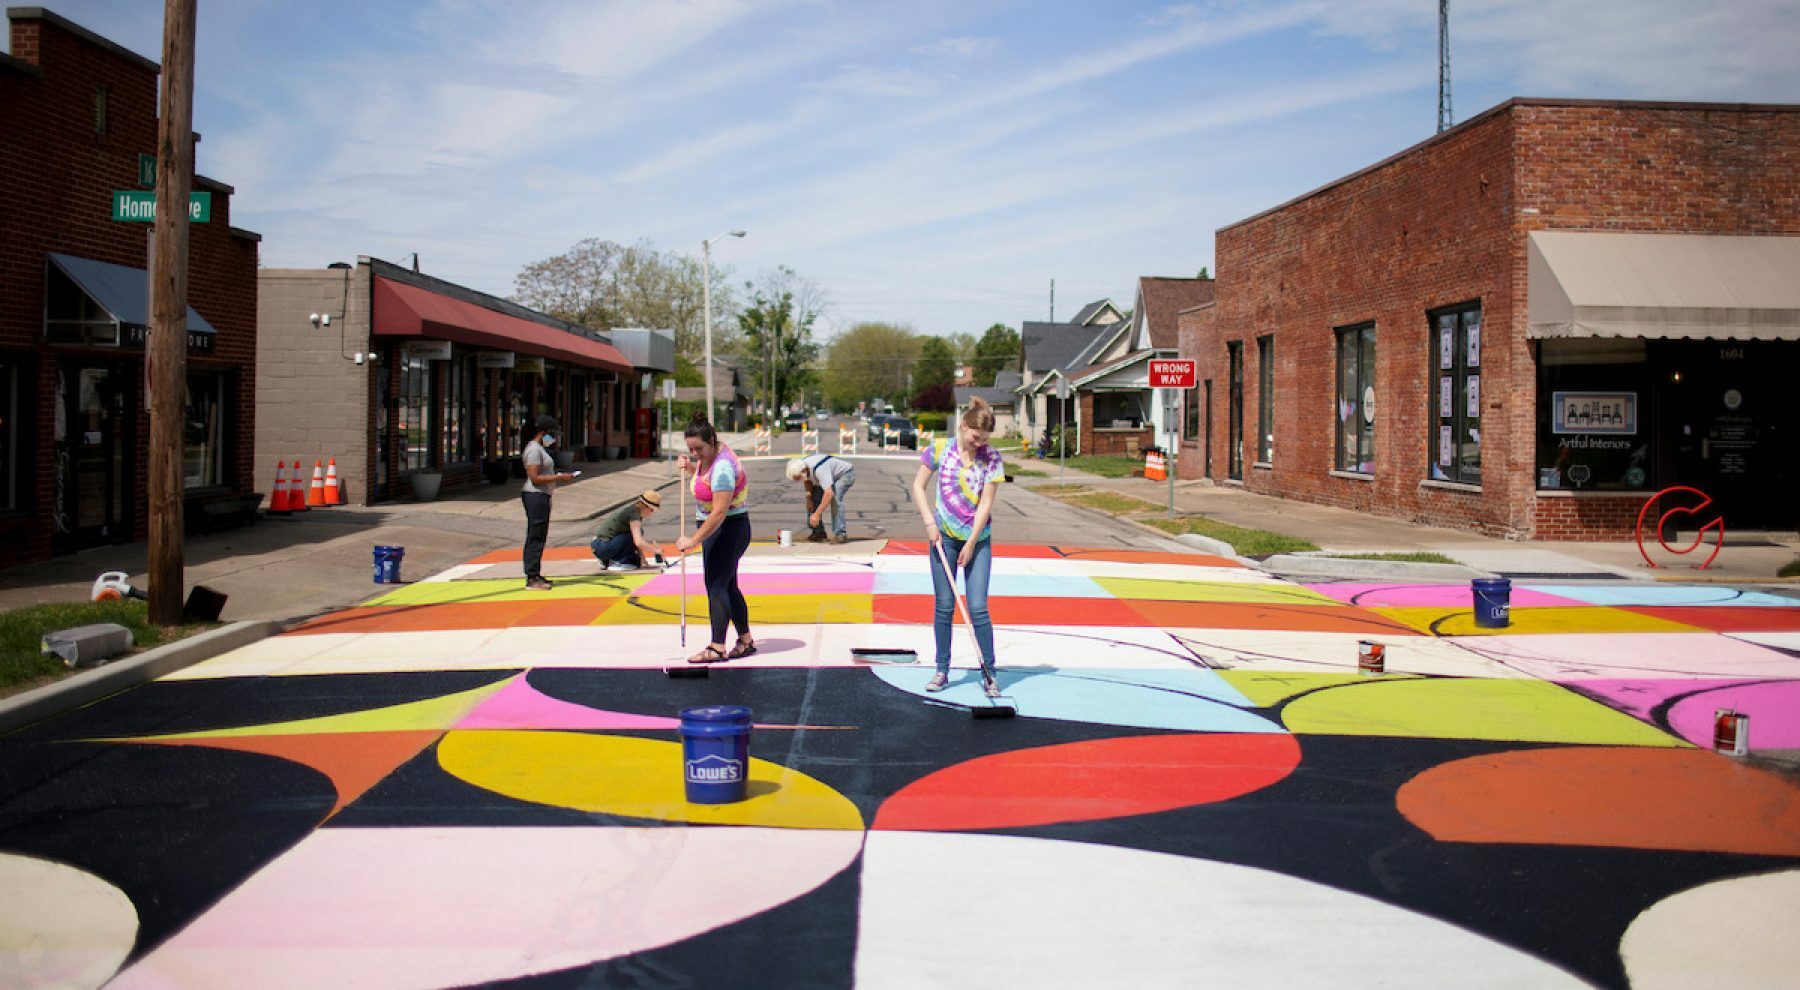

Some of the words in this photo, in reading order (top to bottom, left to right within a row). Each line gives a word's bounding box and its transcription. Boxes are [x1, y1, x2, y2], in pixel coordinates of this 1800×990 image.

[1719, 347, 1744, 360] 1604
[1153, 363, 1191, 374] WRONG
[1160, 374, 1183, 385] WAY
[1558, 434, 1588, 449] Artful
[1589, 437, 1631, 449] Interiors
[689, 764, 738, 780] LOWE'S
